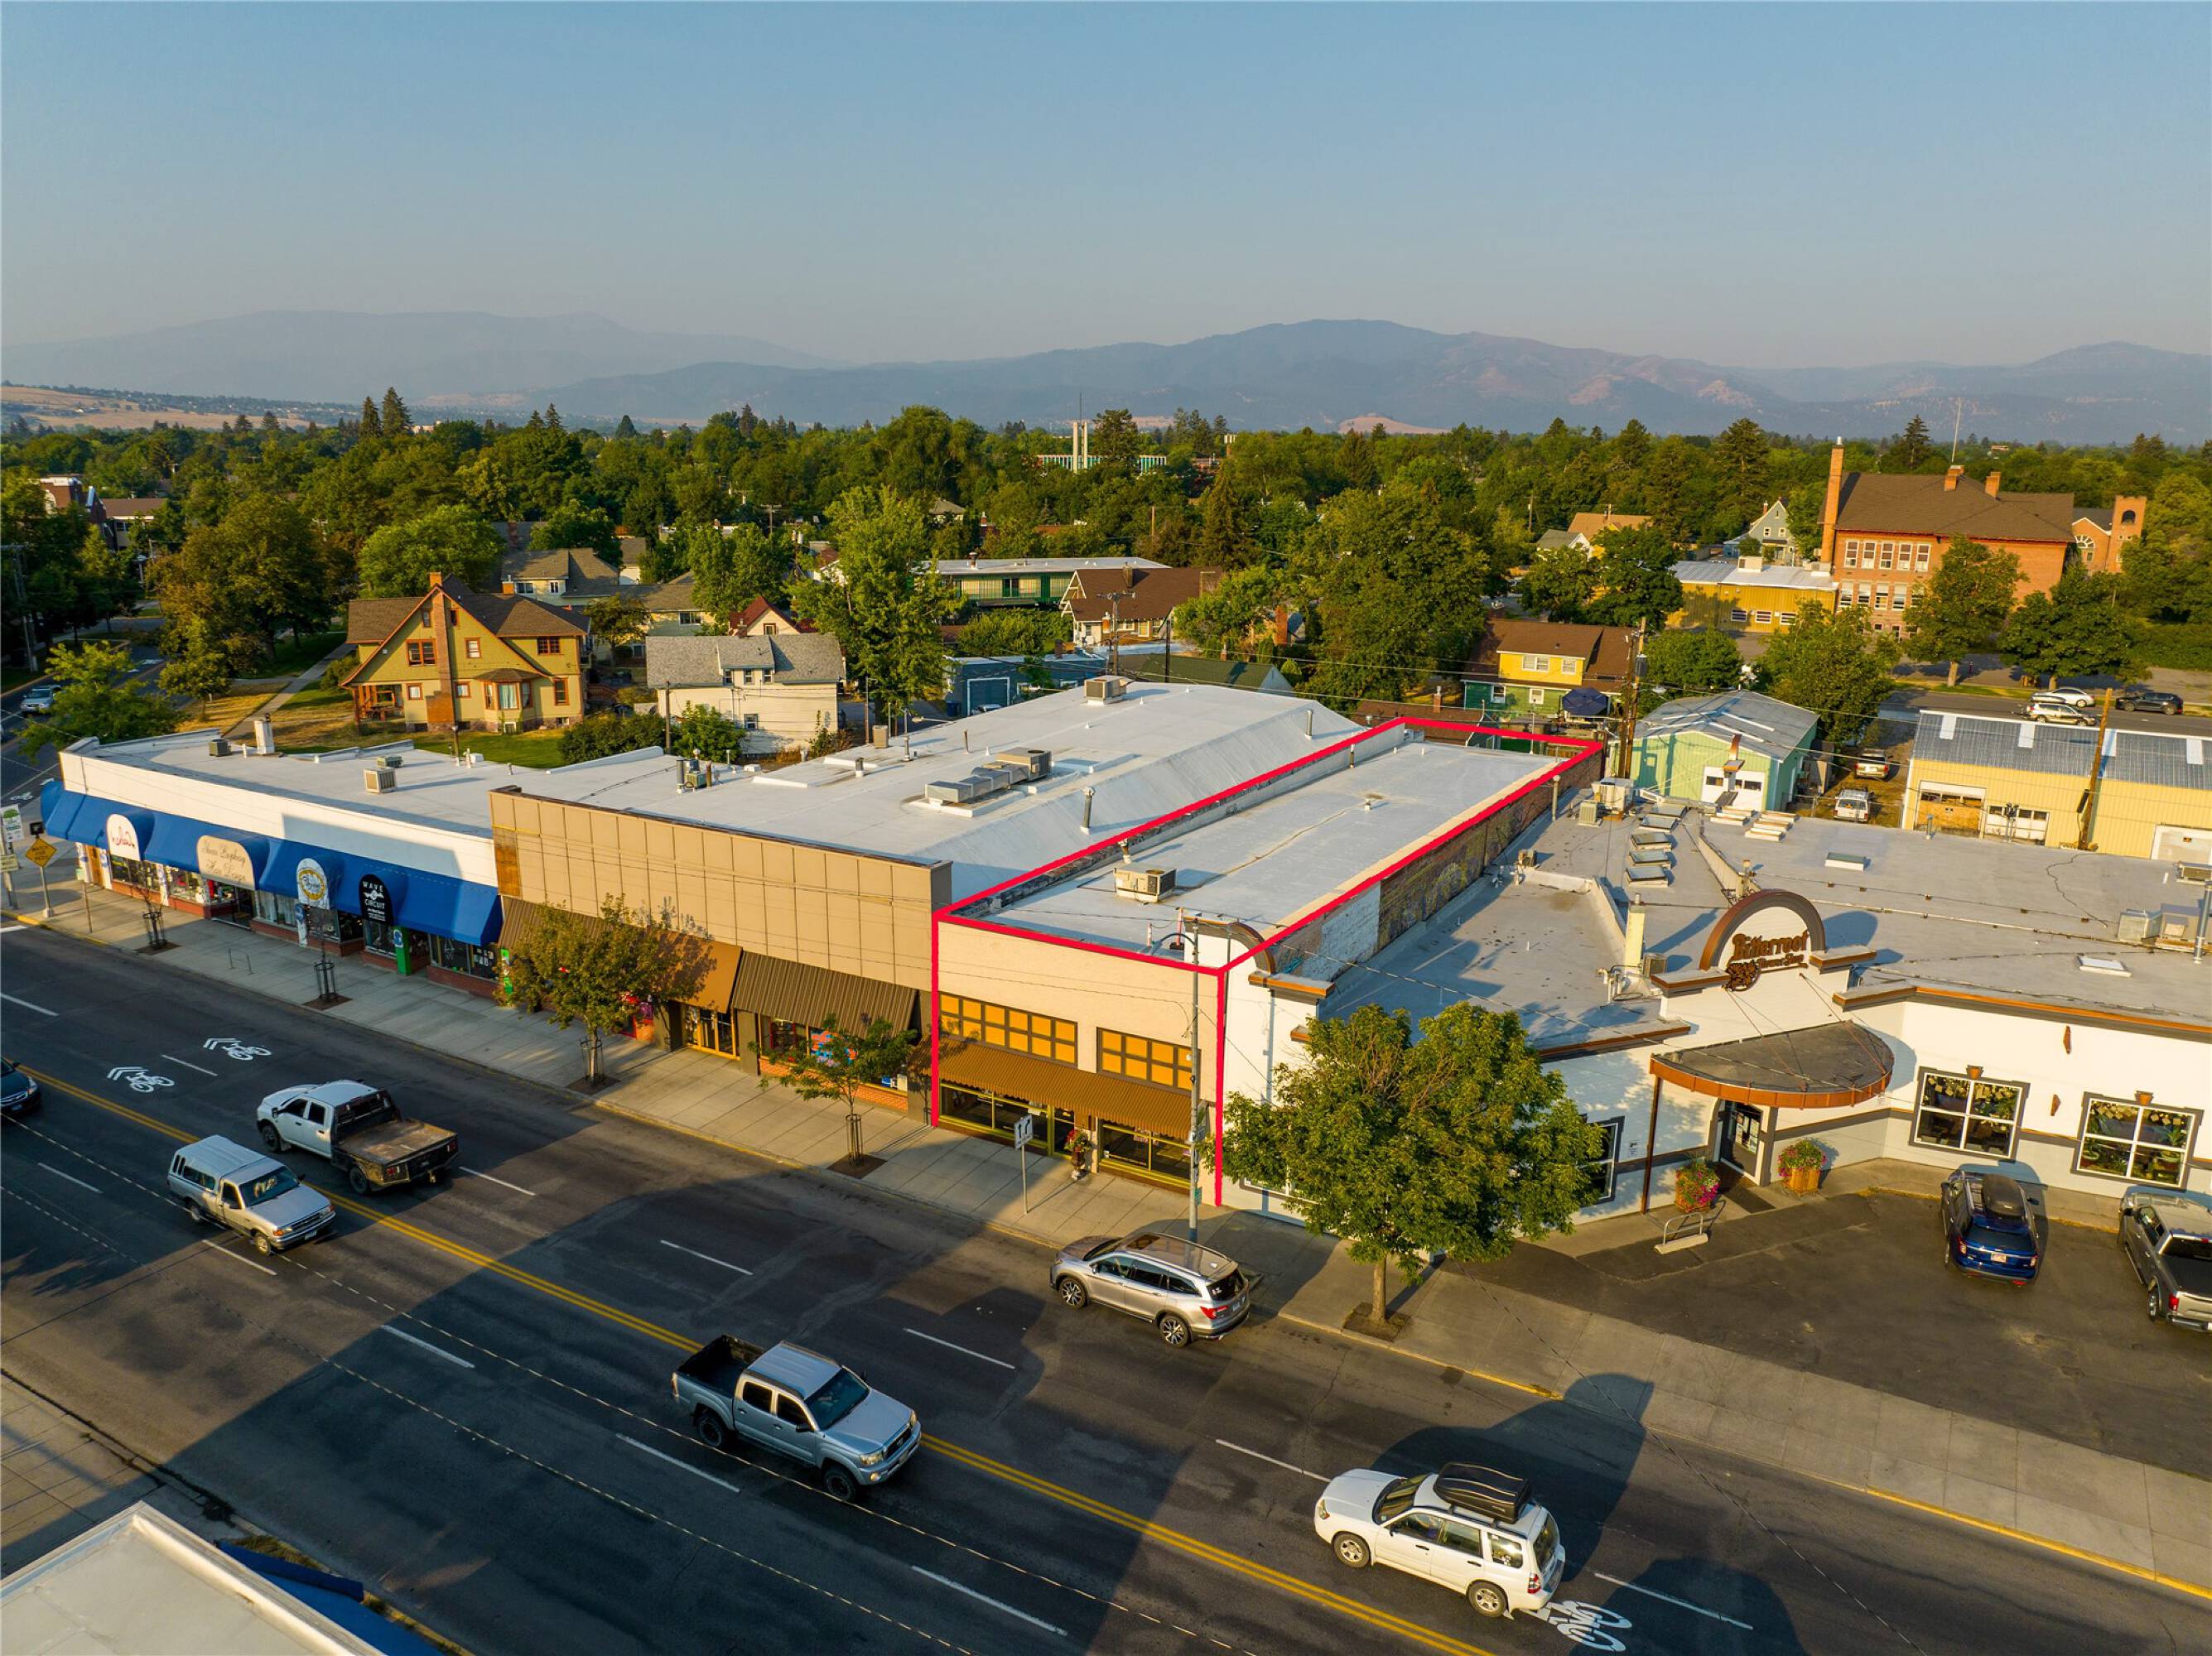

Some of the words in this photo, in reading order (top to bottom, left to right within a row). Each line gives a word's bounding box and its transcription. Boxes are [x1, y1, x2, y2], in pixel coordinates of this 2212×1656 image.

[363, 880, 383, 893] WAVE
[364, 899, 385, 910] CIRCUIT
[1732, 929, 1809, 960] Bitterroot
